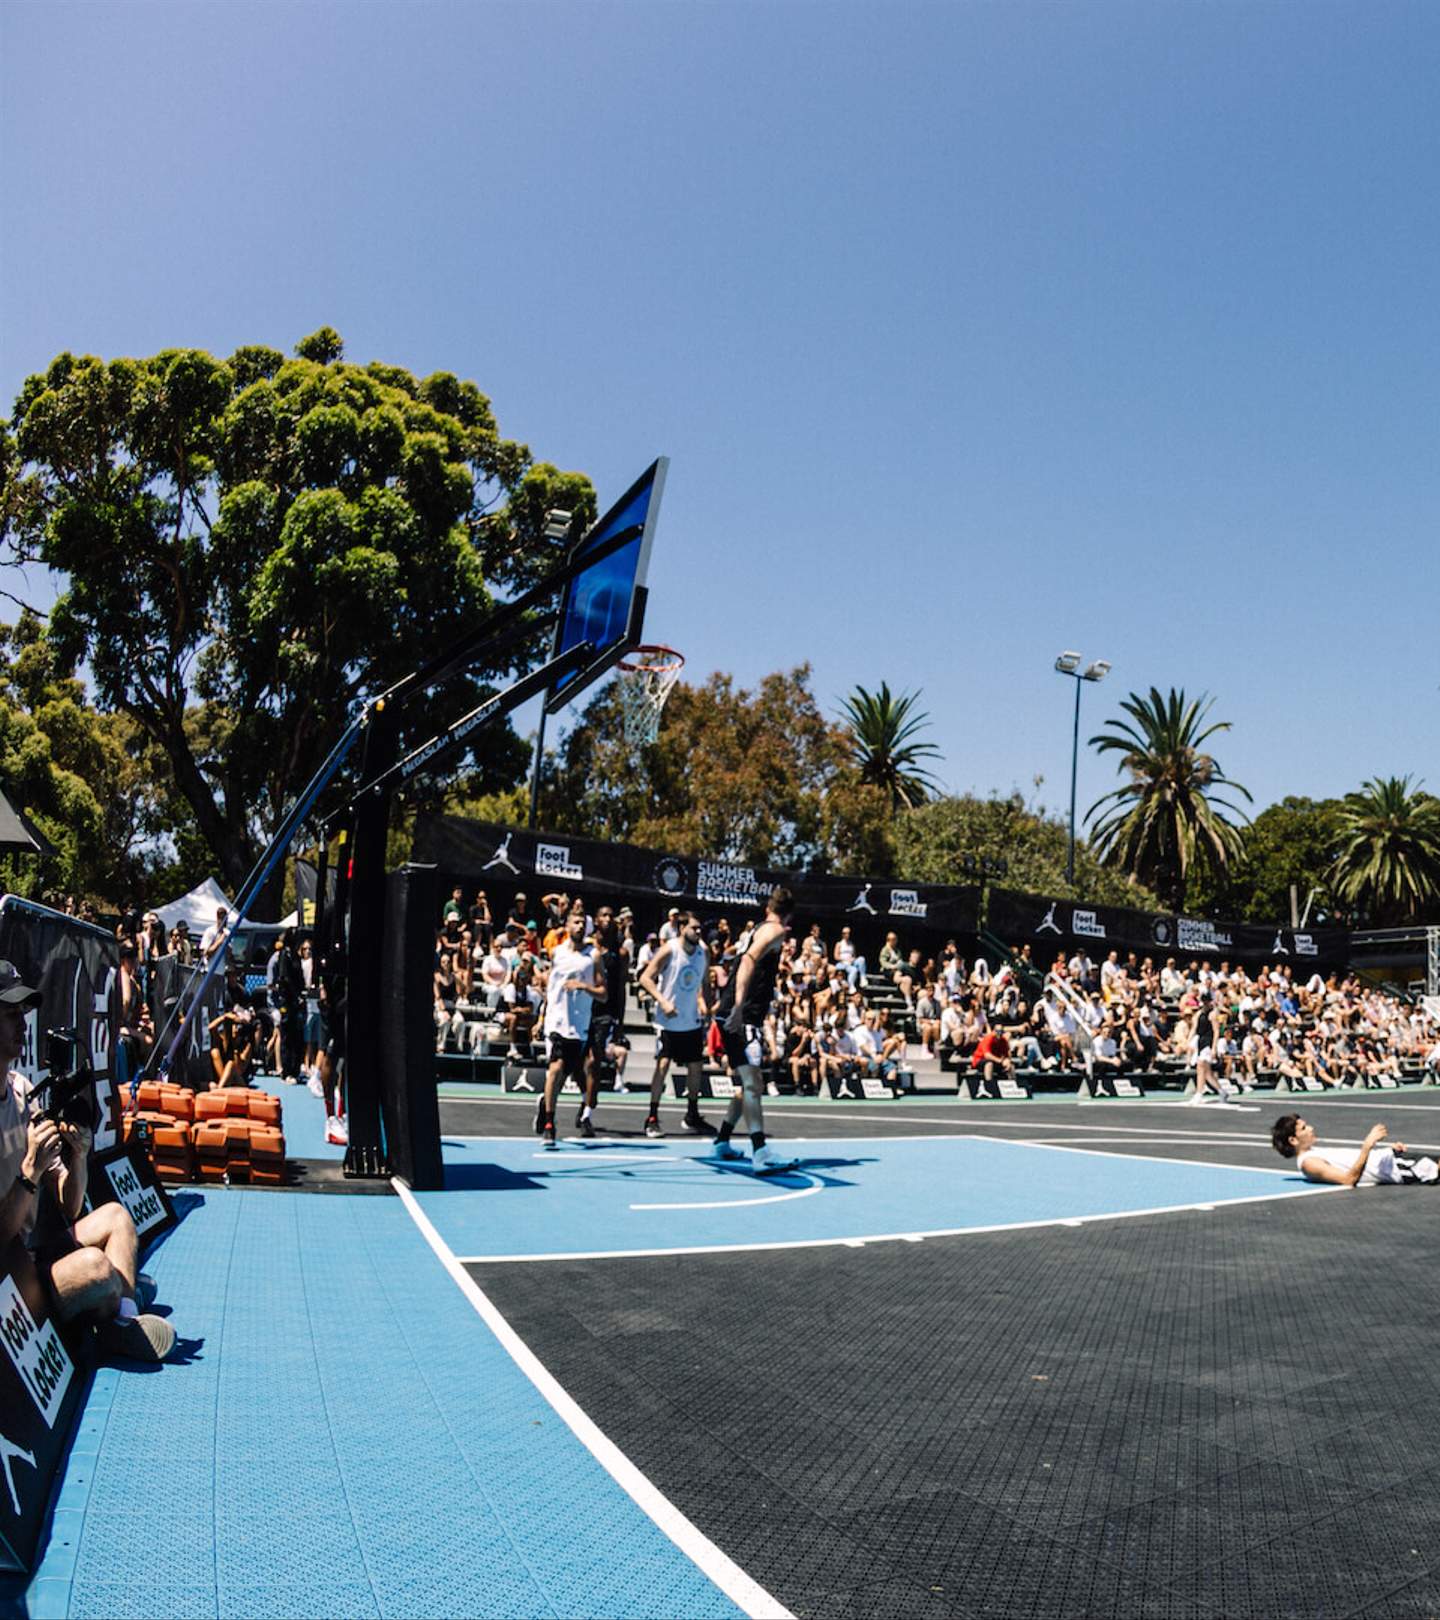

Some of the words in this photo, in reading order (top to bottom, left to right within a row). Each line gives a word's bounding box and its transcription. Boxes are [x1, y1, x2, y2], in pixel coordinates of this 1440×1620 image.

[697, 861, 756, 881] SUMMER
[111, 1166, 139, 1197] Foot
[124, 1193, 162, 1226] Locker
[22, 1333, 66, 1410] Locker
